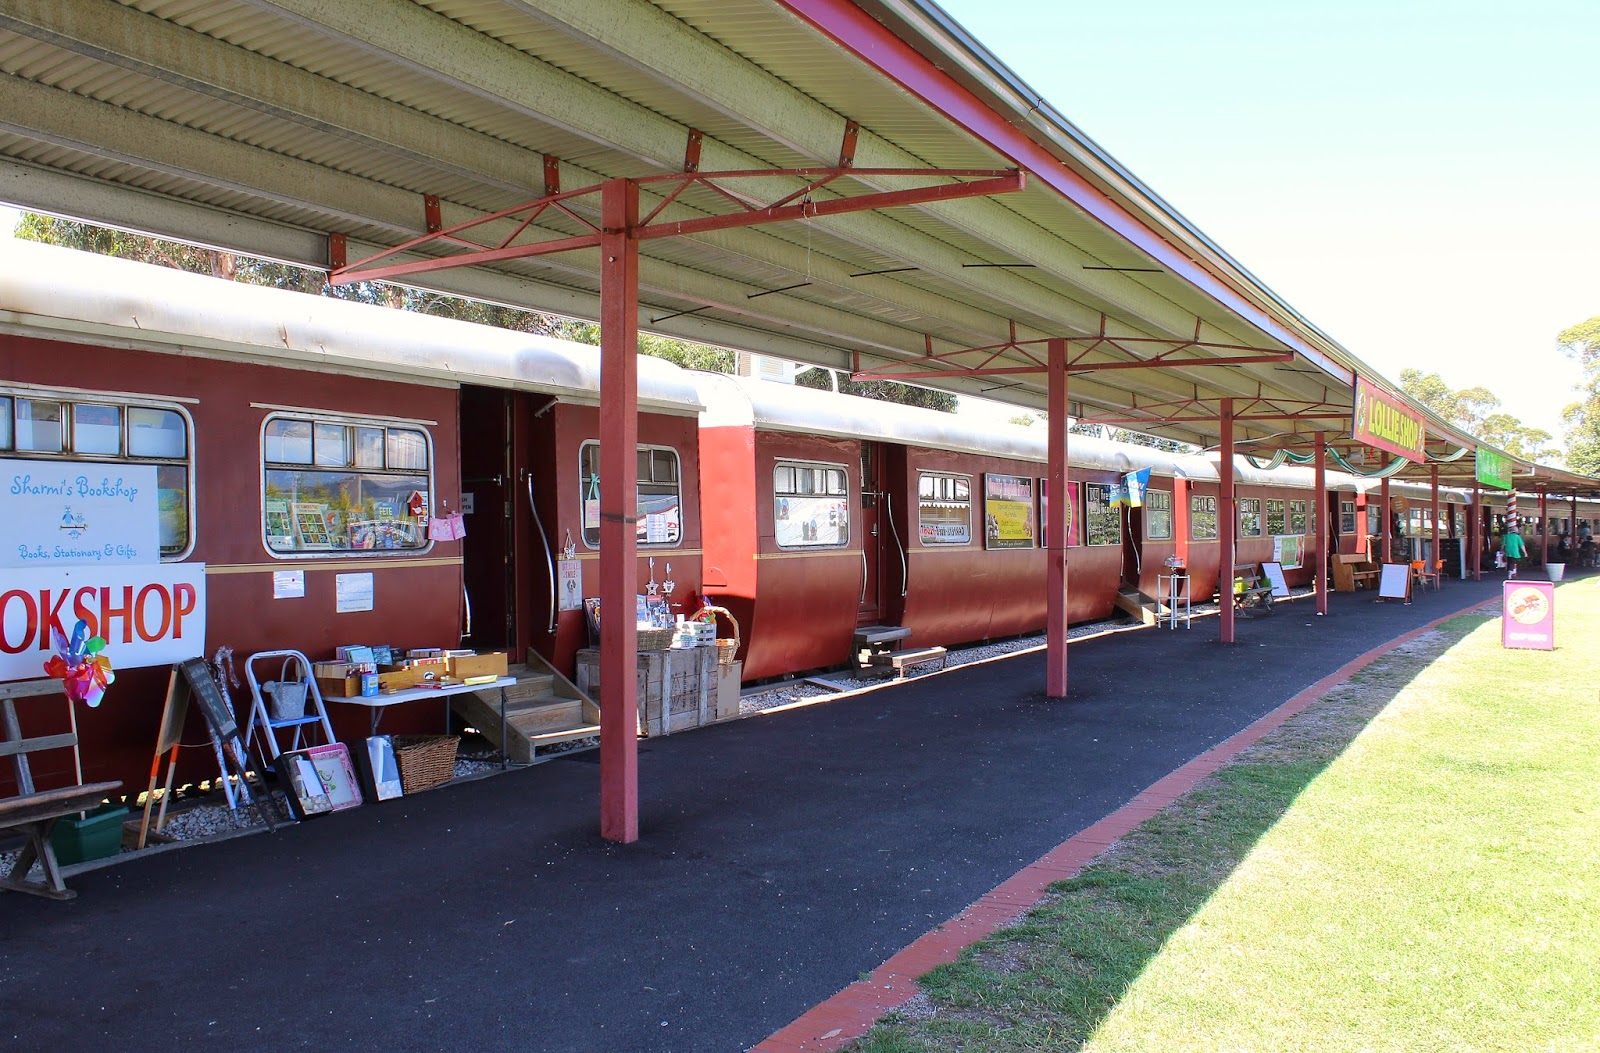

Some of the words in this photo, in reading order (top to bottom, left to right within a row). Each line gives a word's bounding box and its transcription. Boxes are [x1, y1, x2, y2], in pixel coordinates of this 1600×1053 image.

[1368, 396, 1400, 444] LOLLIE
[1400, 414, 1418, 451] SHOP
[10, 474, 73, 496] Sharmi's
[76, 475, 138, 502] Bookshop
[18, 544, 51, 559] Books,
[104, 543, 114, 556] &
[116, 544, 137, 559] Gifts
